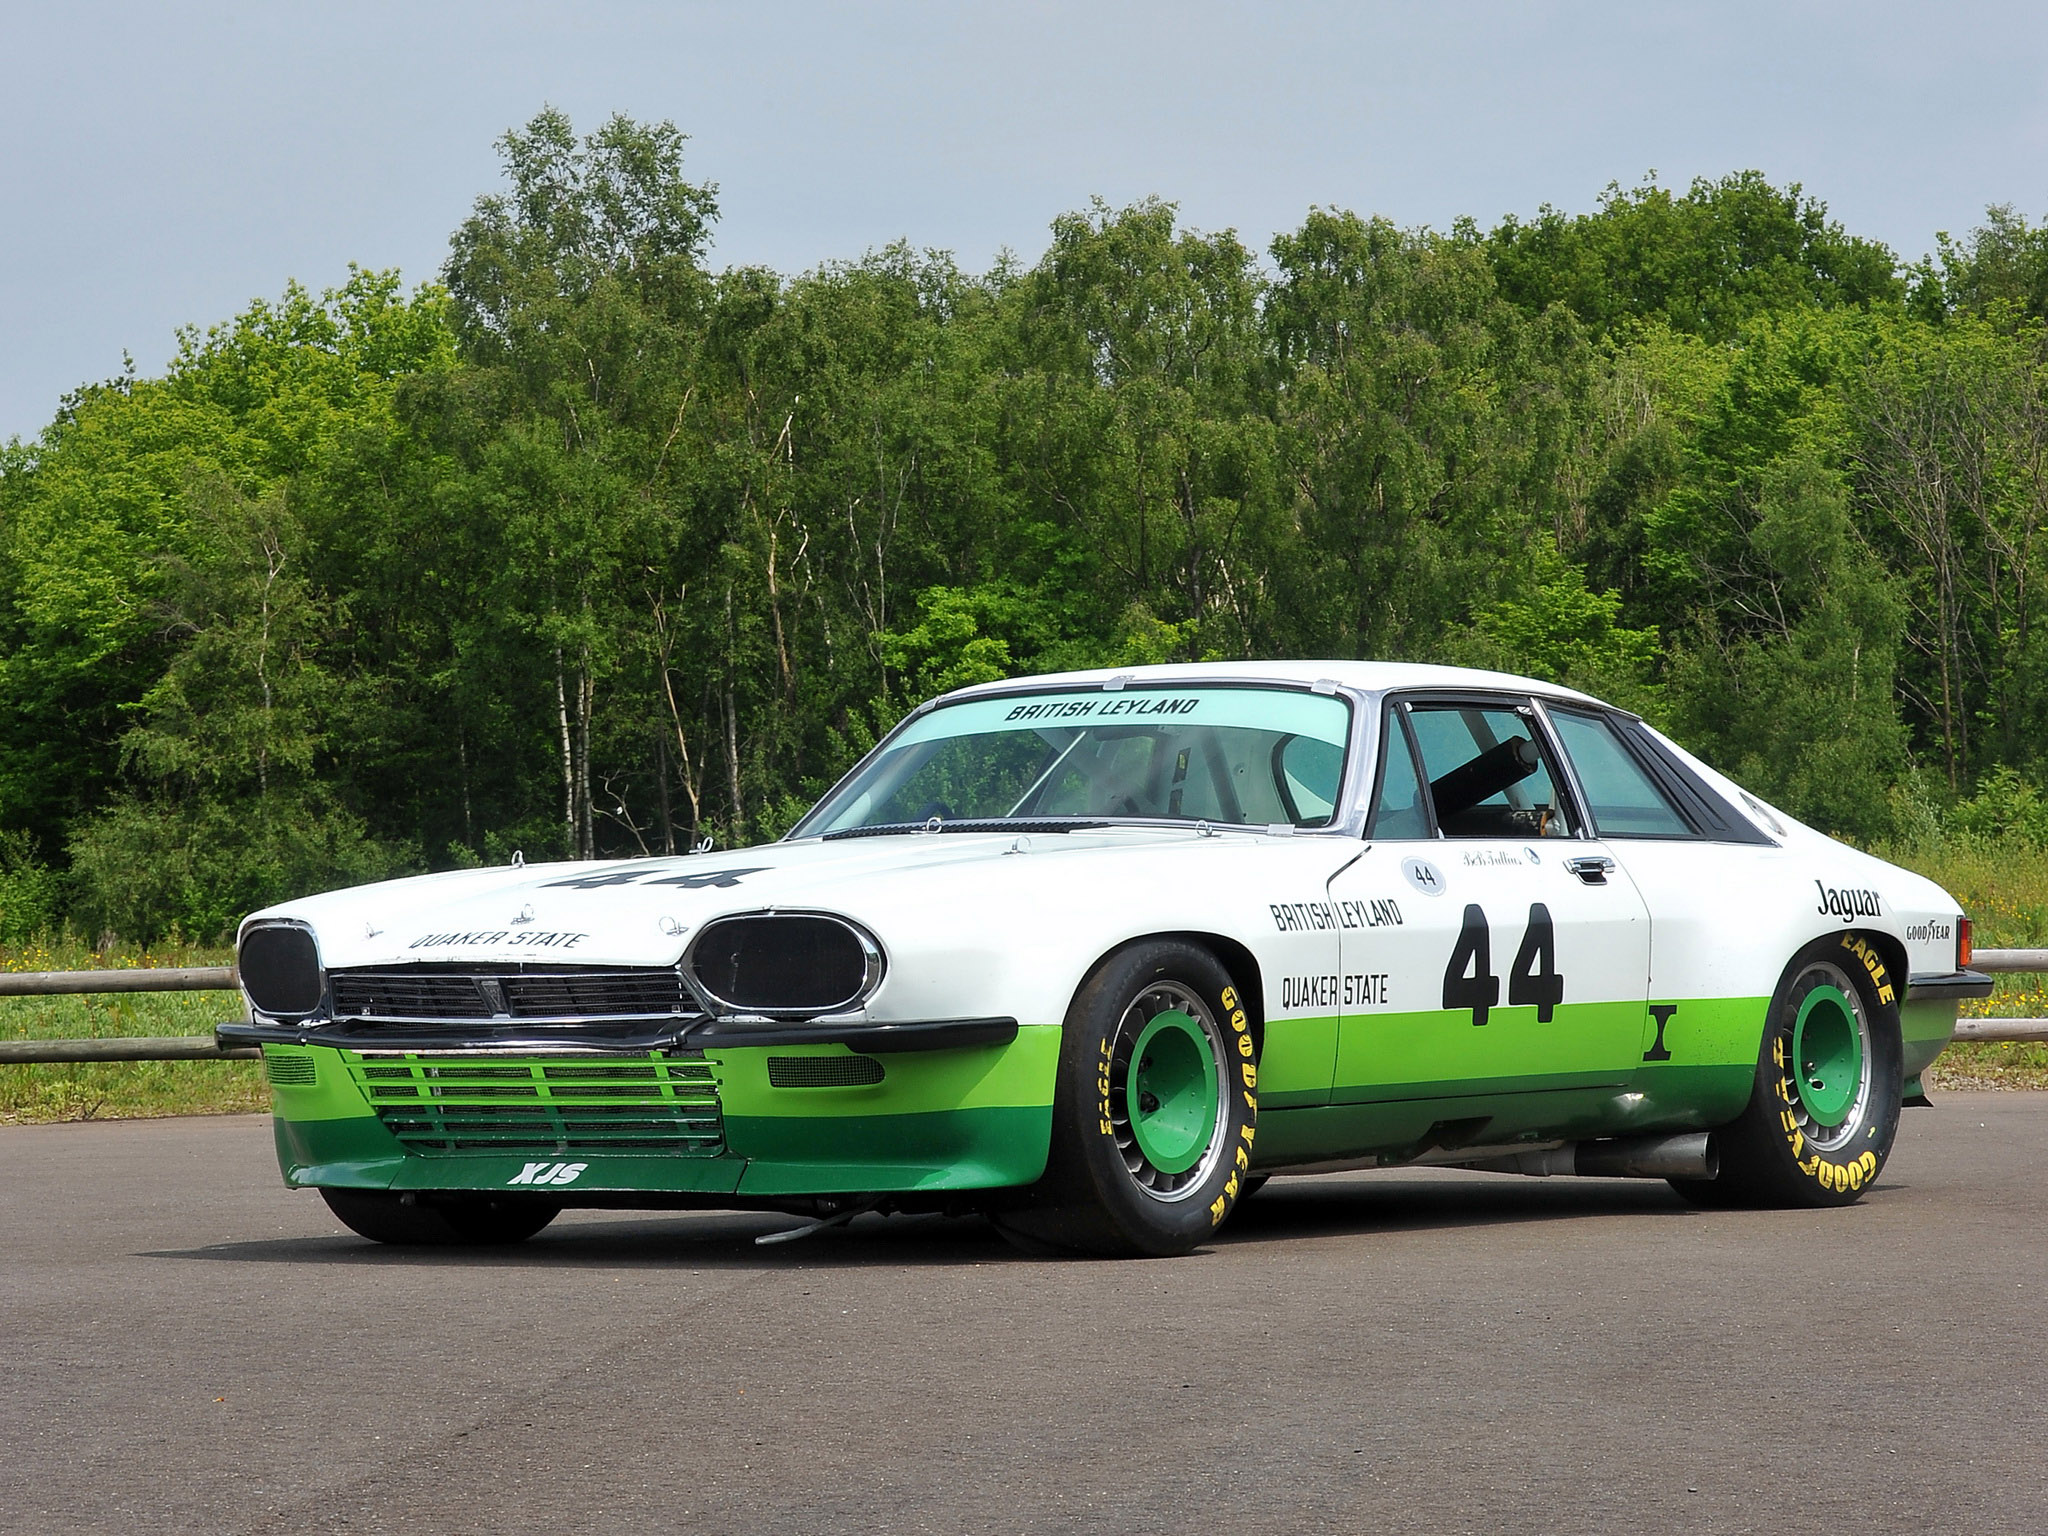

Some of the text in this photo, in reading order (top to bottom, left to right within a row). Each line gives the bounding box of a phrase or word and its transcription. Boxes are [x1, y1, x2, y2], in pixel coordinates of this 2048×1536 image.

[1004, 699, 1200, 721] BRITISH LEYLAND
[537, 867, 776, 890] 44
[1415, 865, 1436, 886] 44
[1269, 899, 1403, 932] BRITISH LEYLAND
[1815, 879, 1882, 923] Jaguar
[408, 931, 590, 949] QUAKER STATE
[1906, 919, 1950, 945] GOODYEAR
[1442, 902, 1564, 1026] 44
[1840, 931, 1895, 1006] EAGLE
[1282, 974, 1388, 1010] QUAKER STATE
[1097, 1037, 1113, 1136] EAGLE
[1210, 985, 1259, 1227] GOODYEAR
[507, 1161, 589, 1186] XJS
